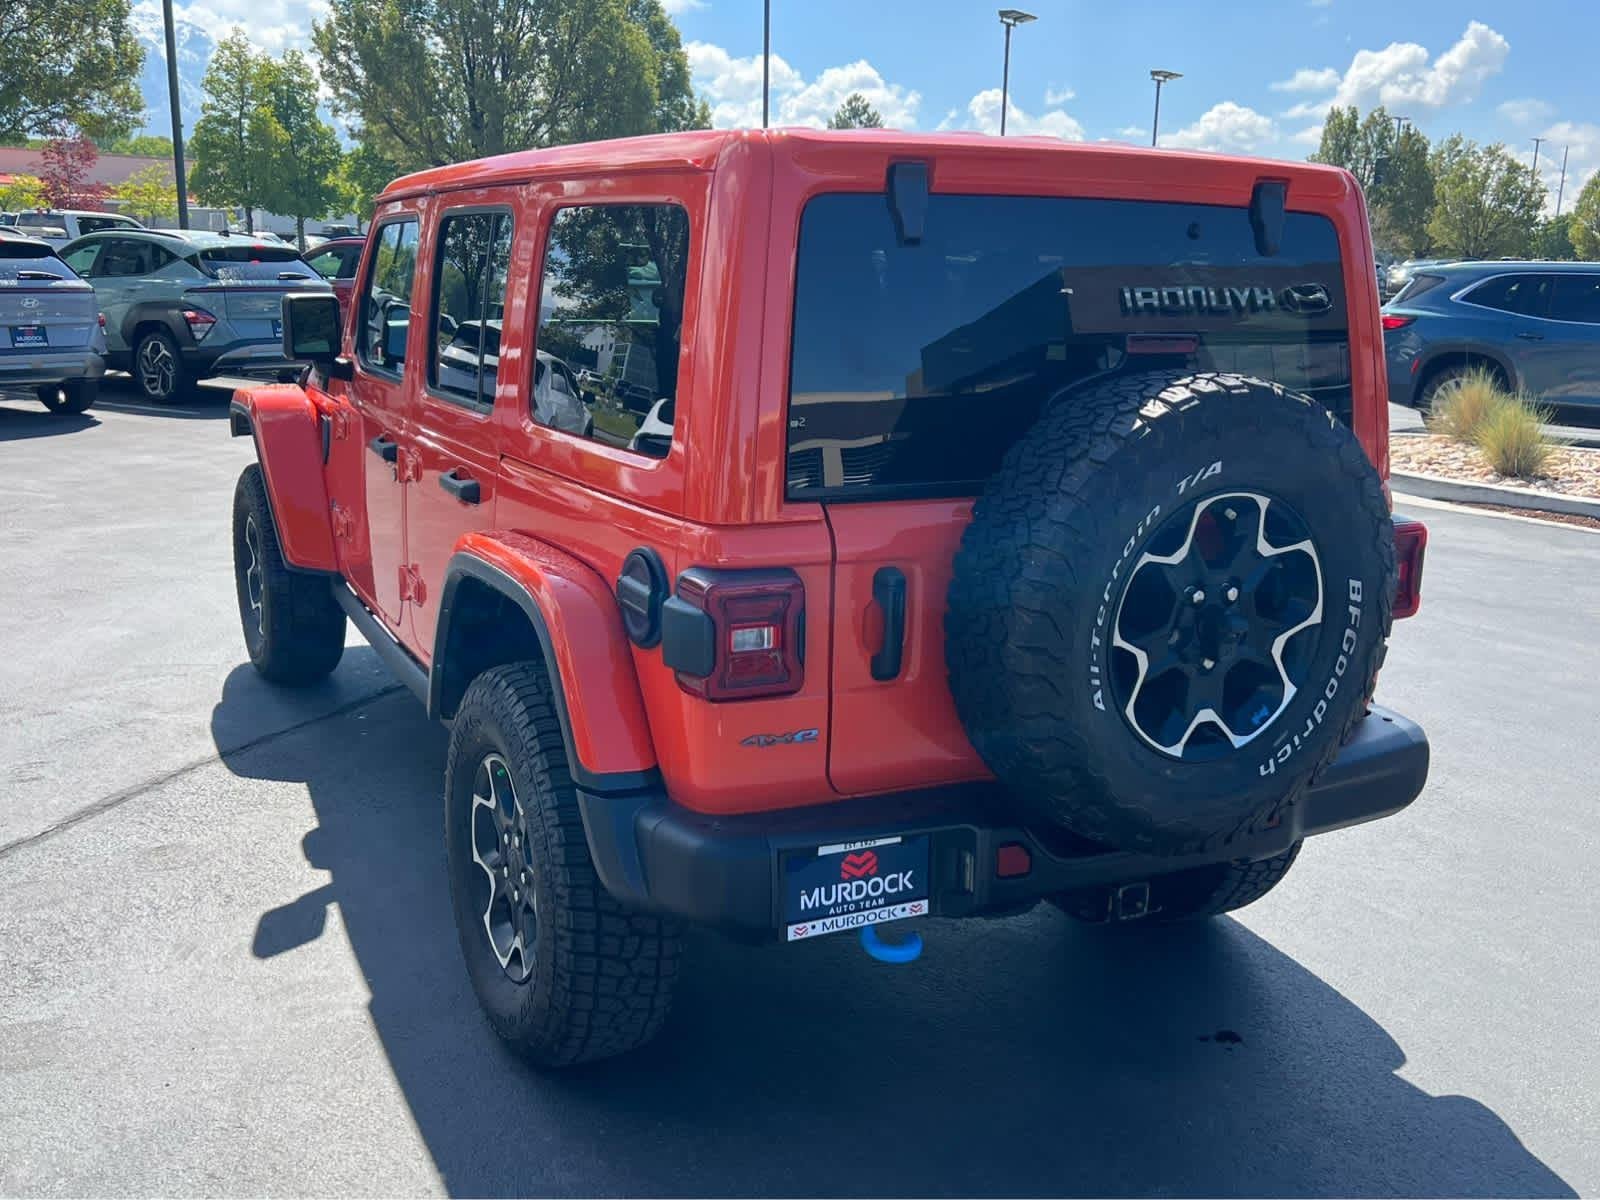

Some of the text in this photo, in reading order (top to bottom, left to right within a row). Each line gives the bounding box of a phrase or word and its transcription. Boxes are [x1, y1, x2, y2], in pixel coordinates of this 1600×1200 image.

[1176, 460, 1223, 495] T/A
[1258, 577, 1363, 777] BFGoodrich
[800, 870, 914, 911] MURDOCK
[829, 897, 885, 916] AUTO TEAM
[821, 906, 898, 932] MURDOCK
